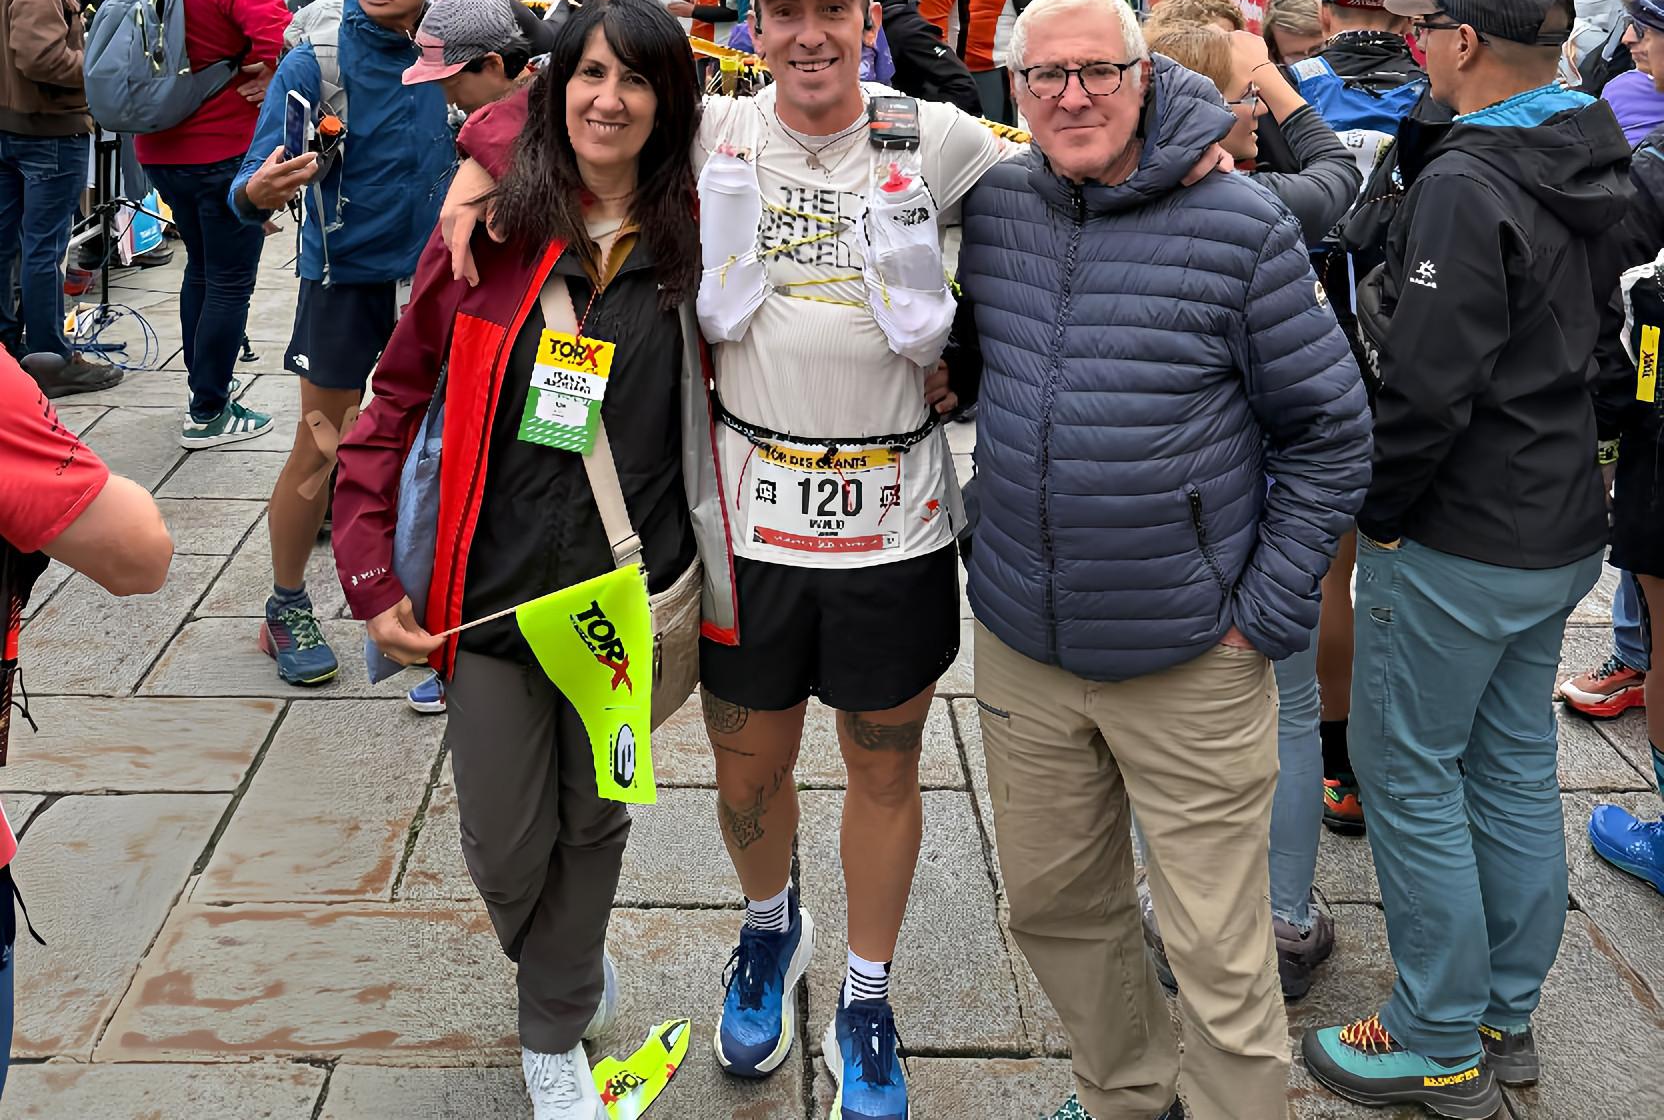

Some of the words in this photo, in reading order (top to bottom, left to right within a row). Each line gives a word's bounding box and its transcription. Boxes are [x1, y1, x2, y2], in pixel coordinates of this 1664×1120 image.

[550, 338, 604, 368] TORX
[798, 478, 862, 517] 120
[573, 599, 633, 697] TORX
